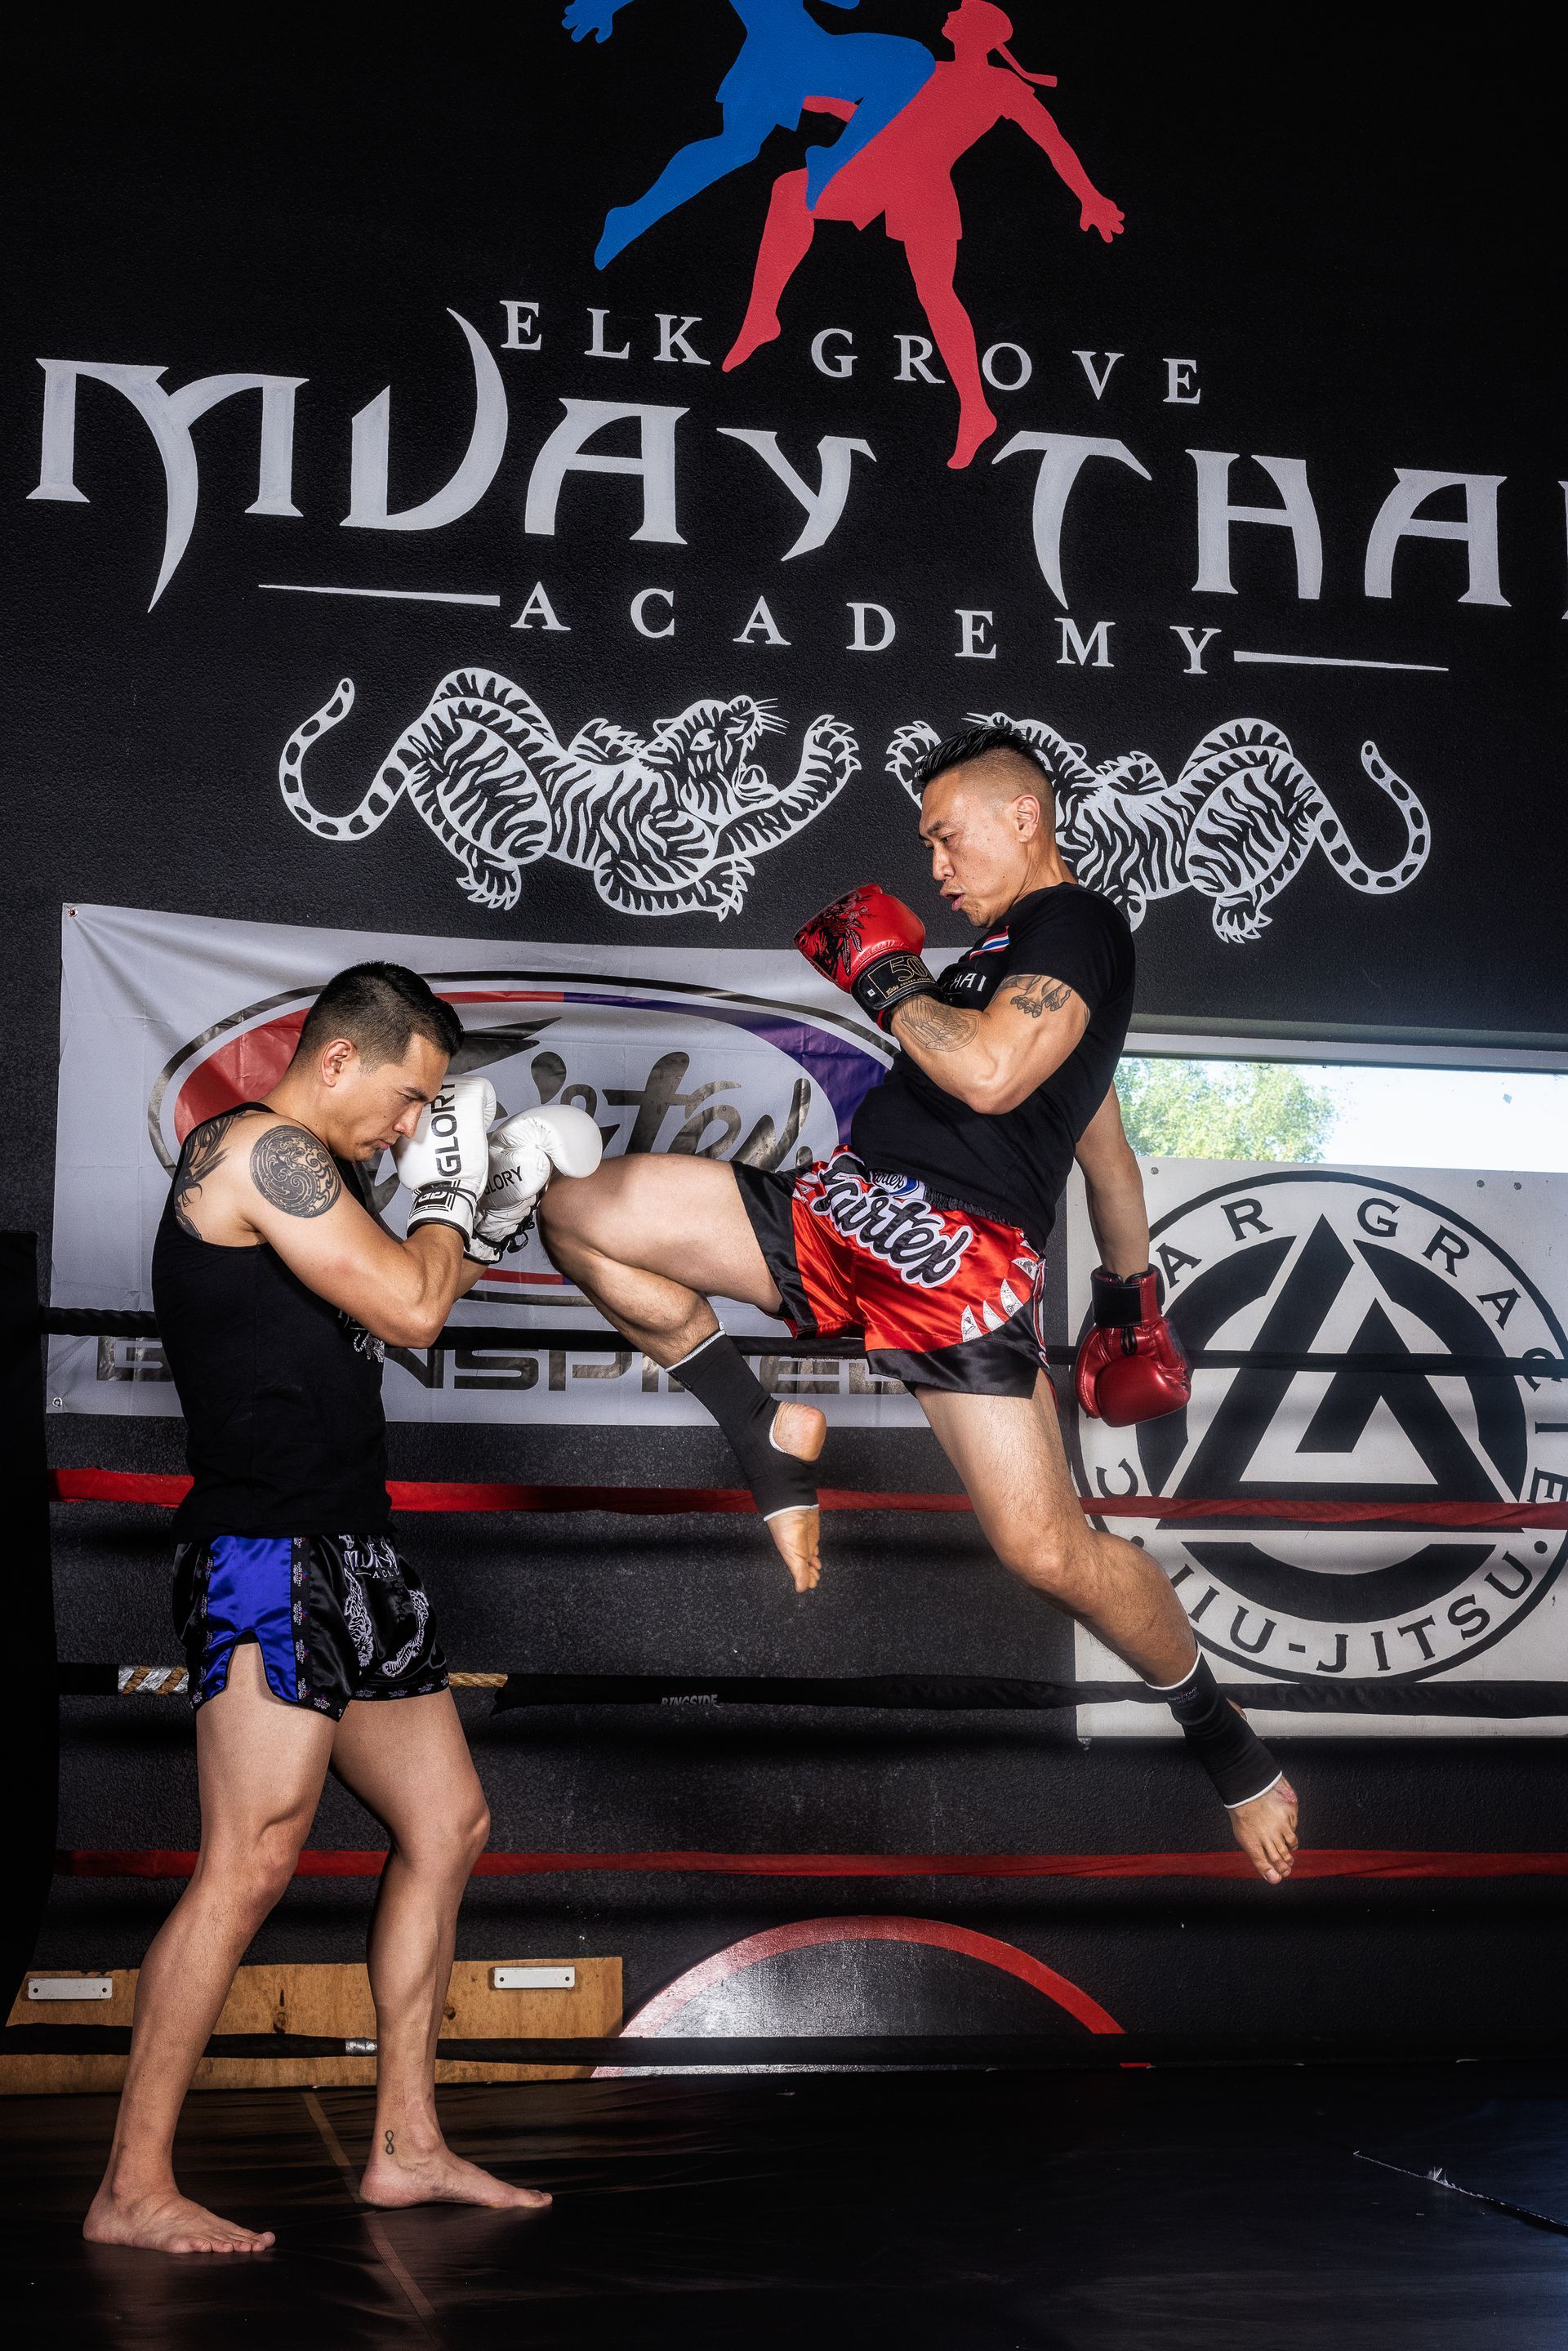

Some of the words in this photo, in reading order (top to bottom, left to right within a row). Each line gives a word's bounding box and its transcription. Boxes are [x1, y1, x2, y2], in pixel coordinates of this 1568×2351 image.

[500, 300, 711, 365] ELK
[811, 328, 1202, 404] GROVE
[26, 307, 876, 612] MUAY
[992, 430, 1568, 619] THA
[510, 581, 1222, 675] ACADEMY
[944, 972, 987, 992] HAI
